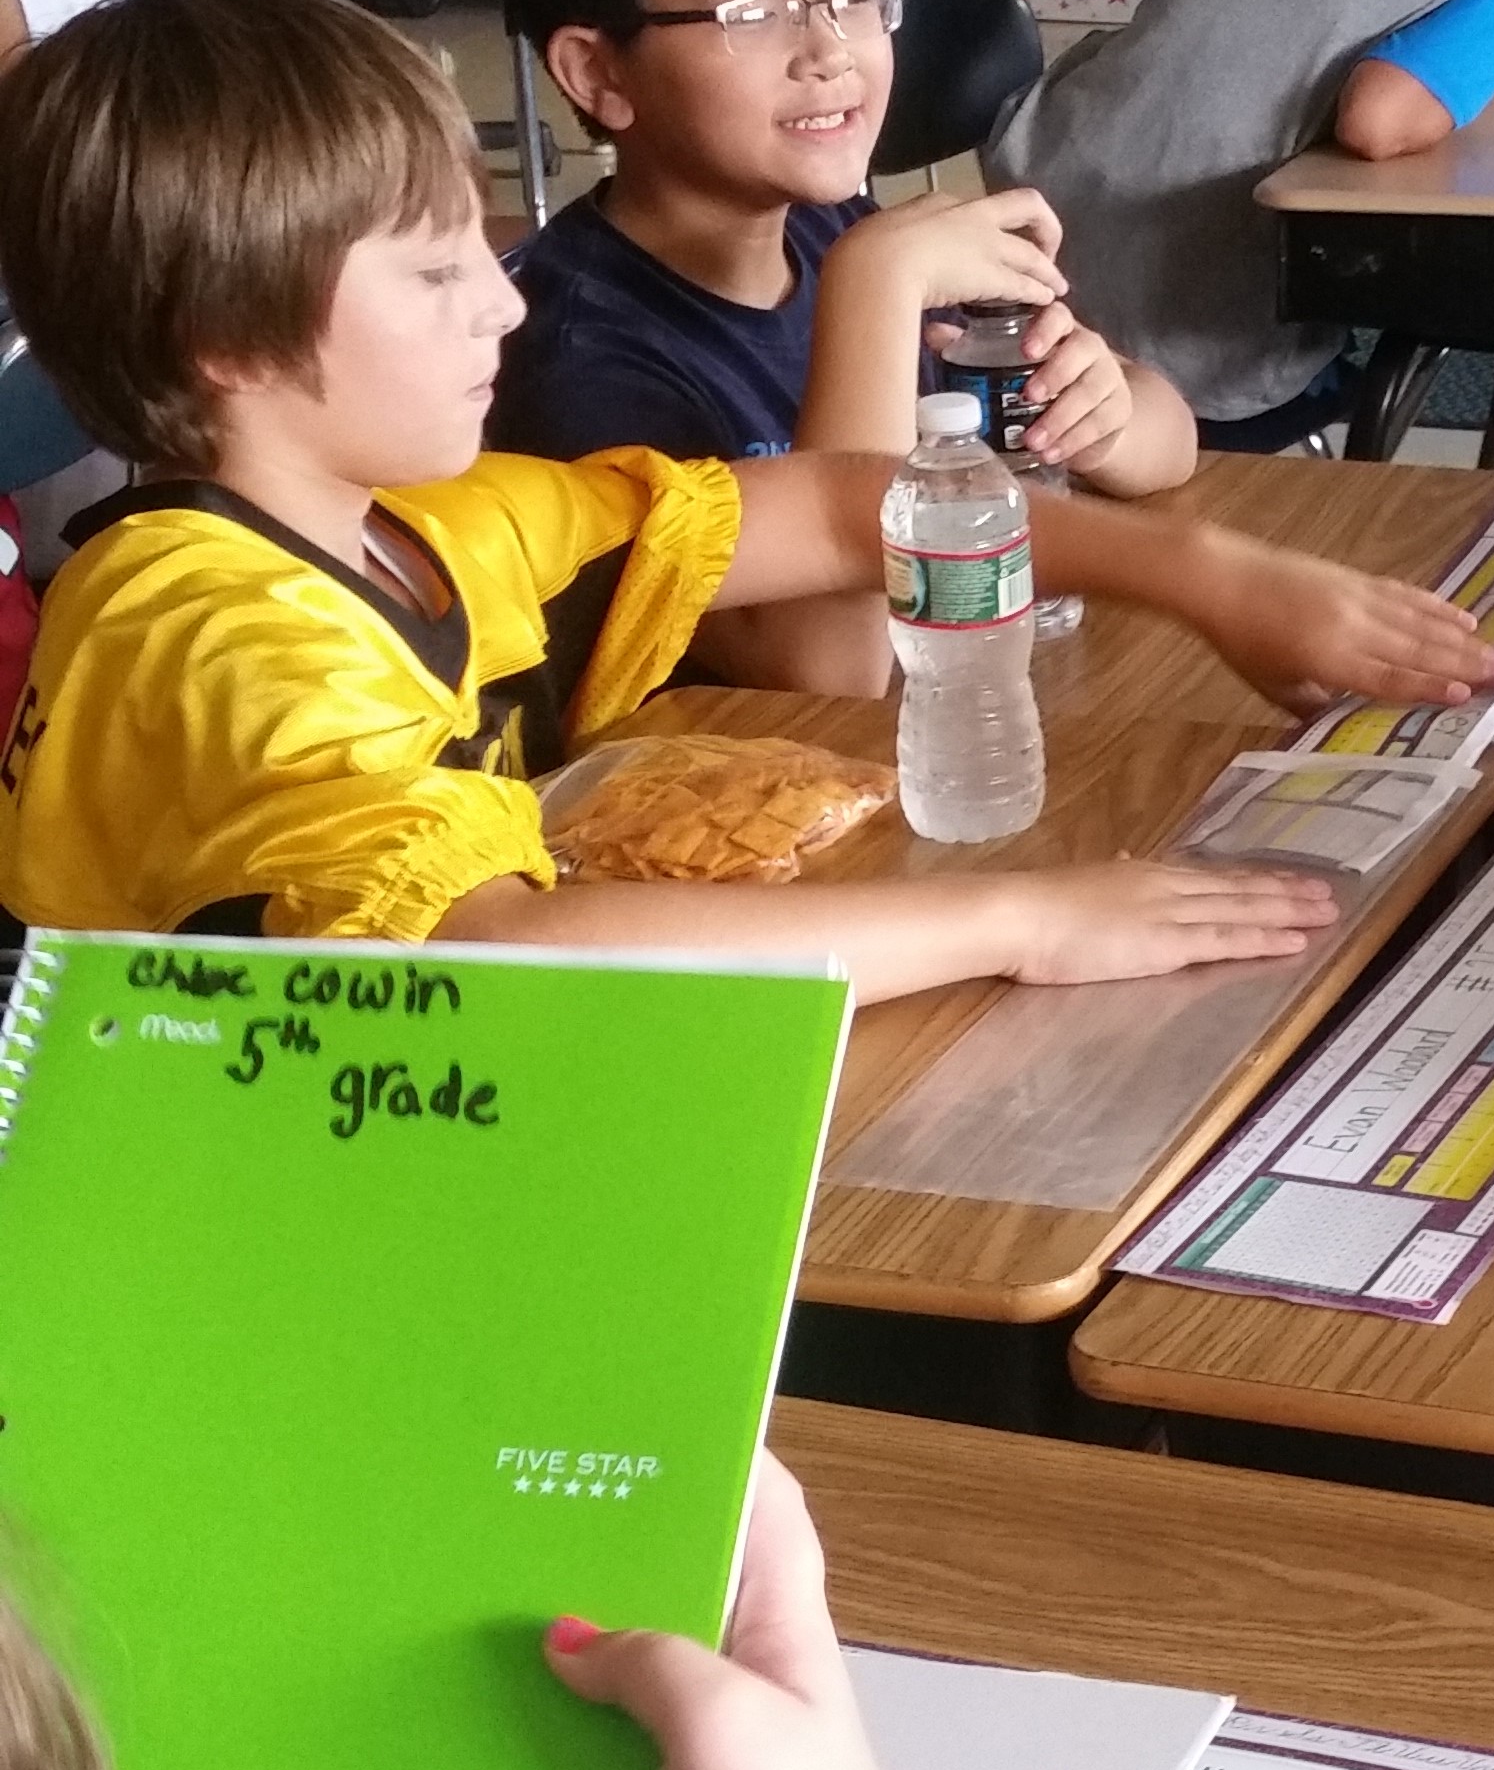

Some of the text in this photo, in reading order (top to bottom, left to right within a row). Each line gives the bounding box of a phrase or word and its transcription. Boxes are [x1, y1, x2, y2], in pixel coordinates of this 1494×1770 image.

[224, 1013, 320, 1083] 5th
[329, 1059, 500, 1139] grade
[1303, 1105, 1390, 1153] Evan
[496, 1447, 659, 1478] FIVE STAR
